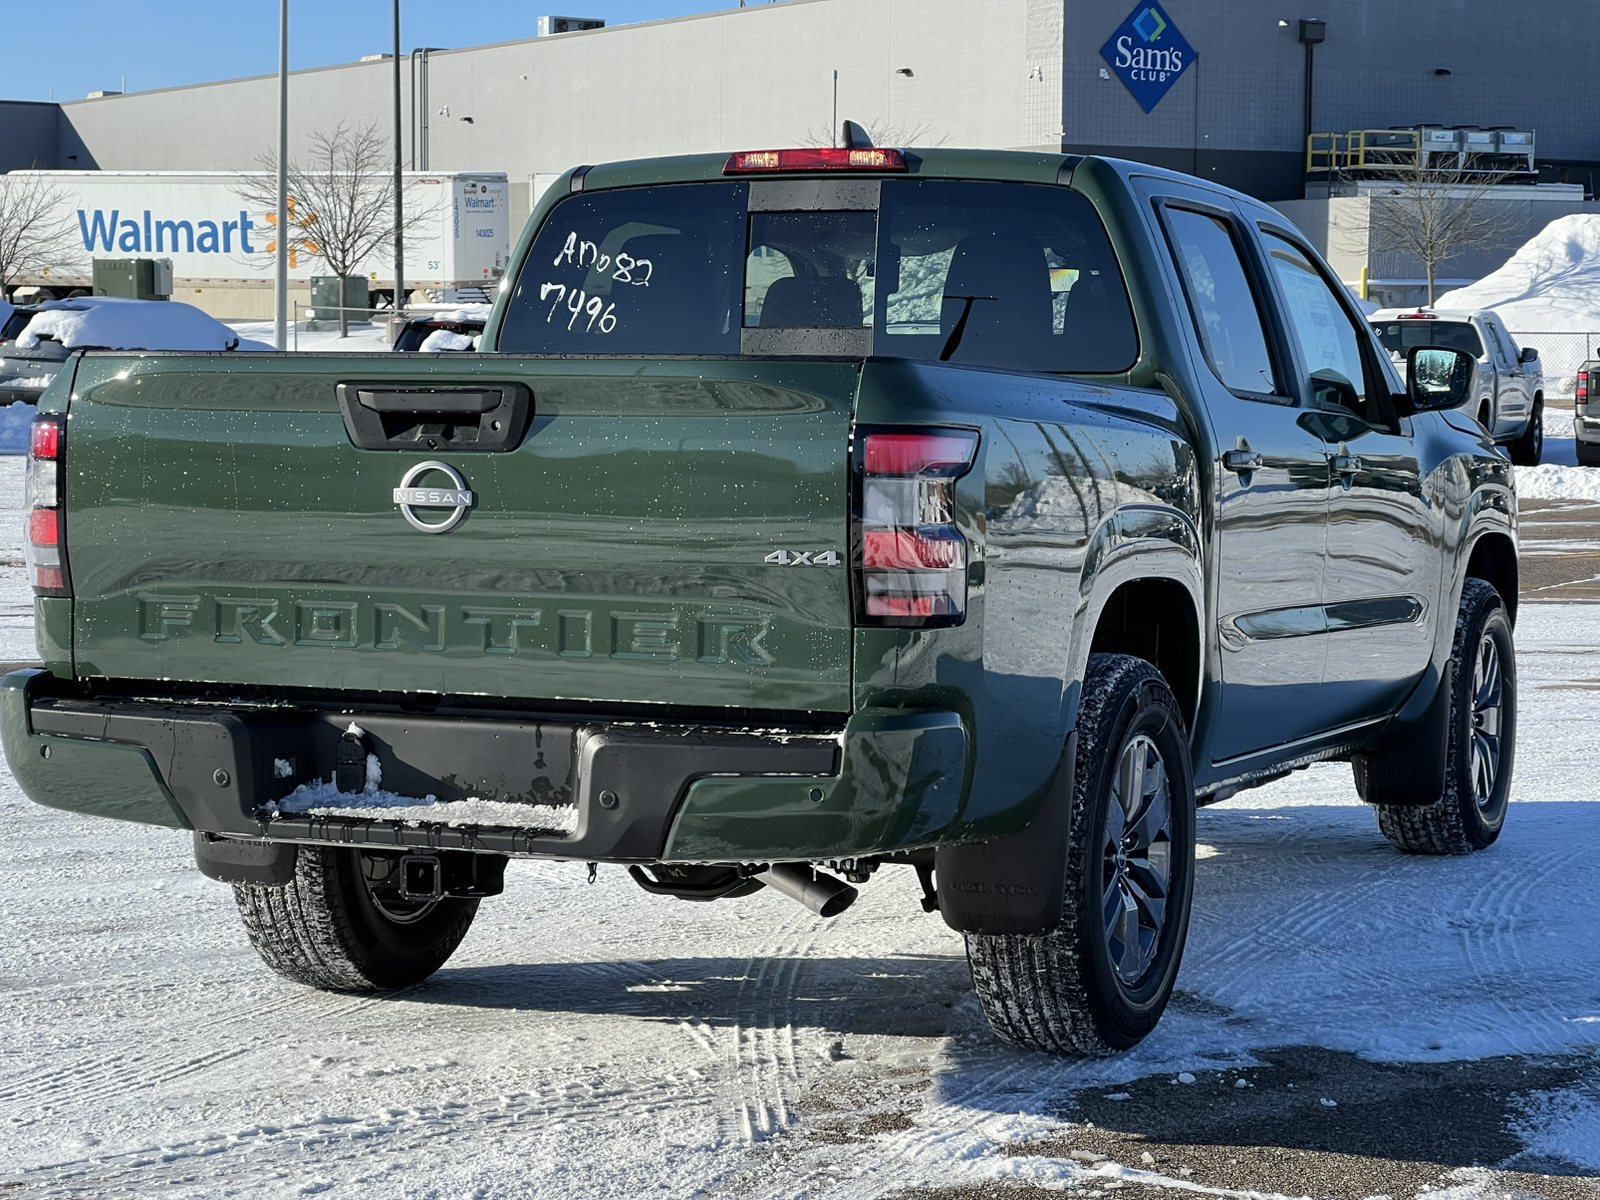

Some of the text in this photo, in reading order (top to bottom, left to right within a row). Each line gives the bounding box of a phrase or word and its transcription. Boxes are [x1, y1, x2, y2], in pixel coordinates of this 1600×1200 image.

[1115, 35, 1182, 72] Sam's
[1131, 69, 1166, 82] CLUB
[464, 197, 495, 208] Walmart
[77, 209, 255, 254] Walmart
[540, 282, 617, 333] 7496
[396, 491, 470, 504] NISSAN
[137, 590, 776, 667] FRONTIER
